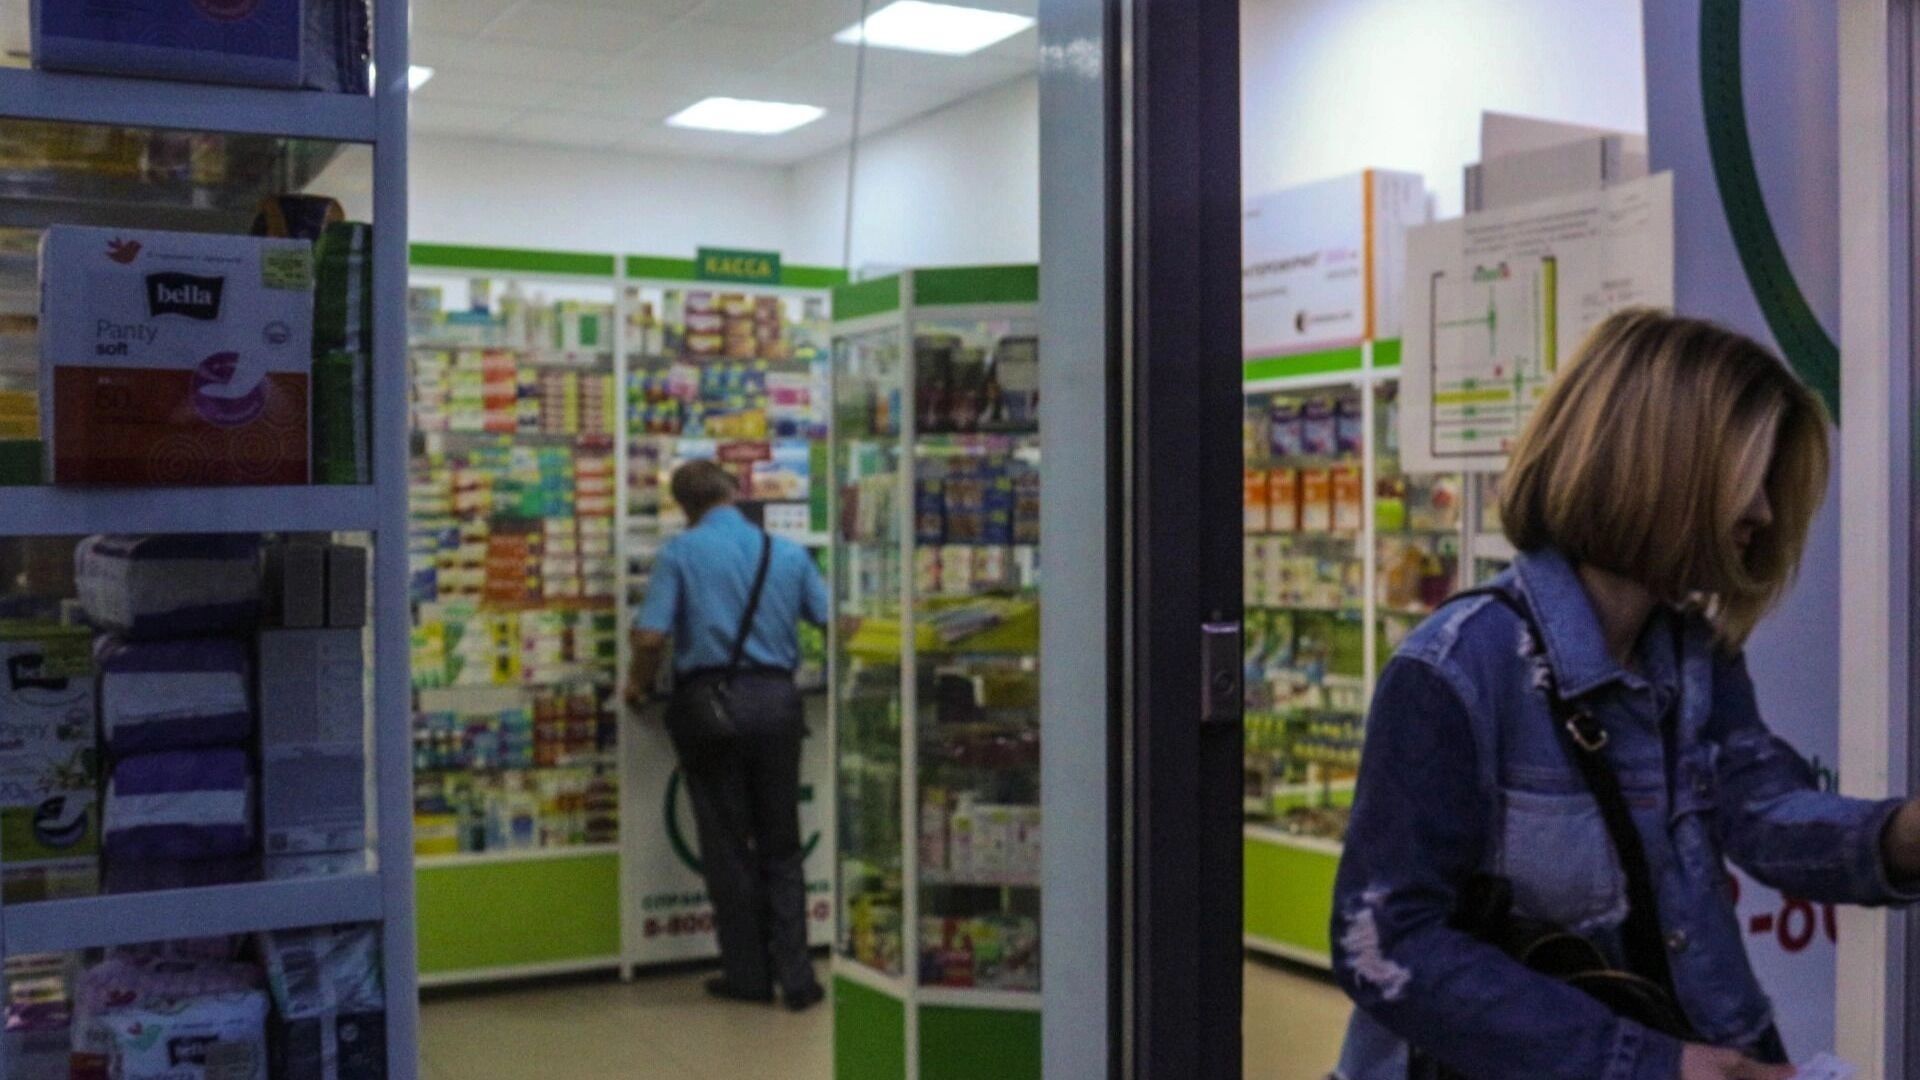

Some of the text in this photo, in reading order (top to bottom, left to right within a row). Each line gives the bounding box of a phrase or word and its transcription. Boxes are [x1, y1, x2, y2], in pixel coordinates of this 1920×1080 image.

[705, 255, 772, 277] КАССА
[156, 283, 212, 305] bella
[96, 319, 158, 345] Panty
[96, 341, 128, 355] soft
